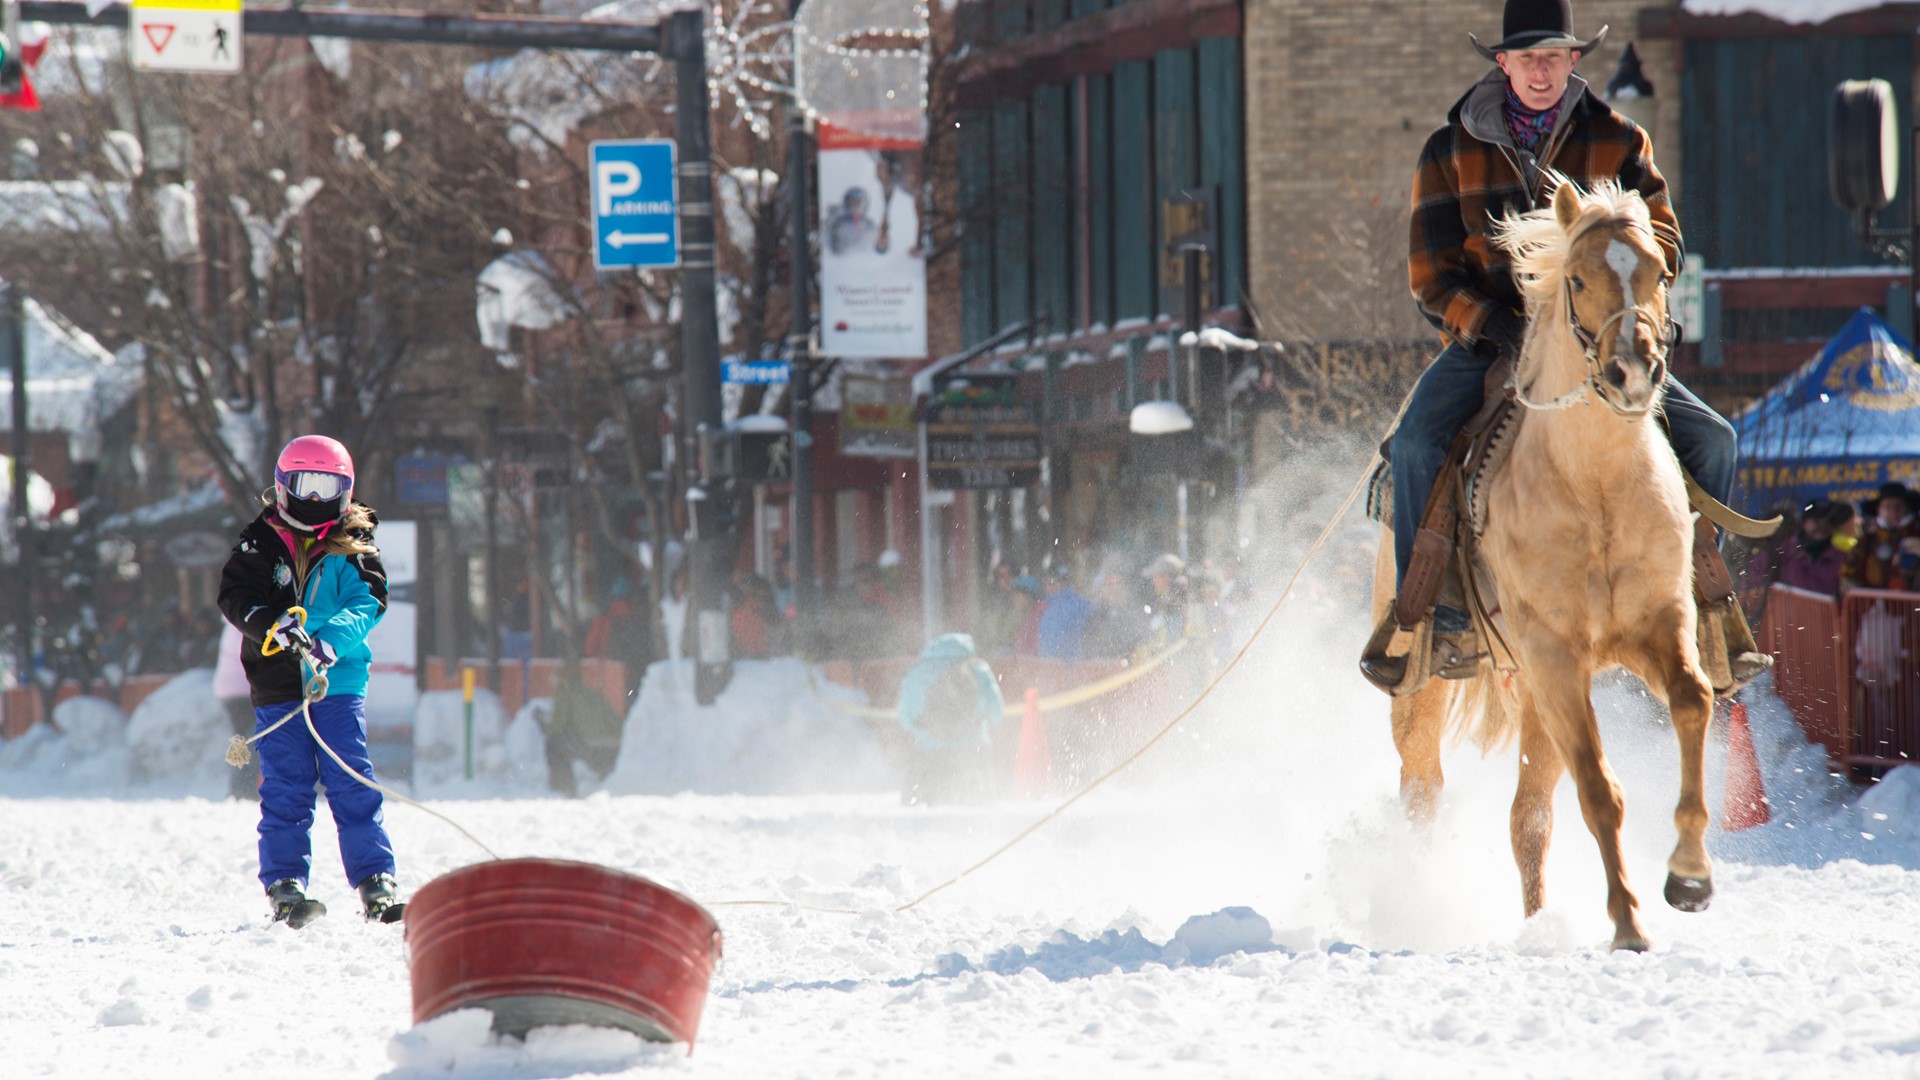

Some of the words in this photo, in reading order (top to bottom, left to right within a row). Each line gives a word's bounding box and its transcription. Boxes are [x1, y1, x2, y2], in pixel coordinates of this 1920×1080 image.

[597, 160, 673, 217] PARKING
[728, 361, 789, 382] Street
[1739, 460, 1880, 488] STEAMBOAT
